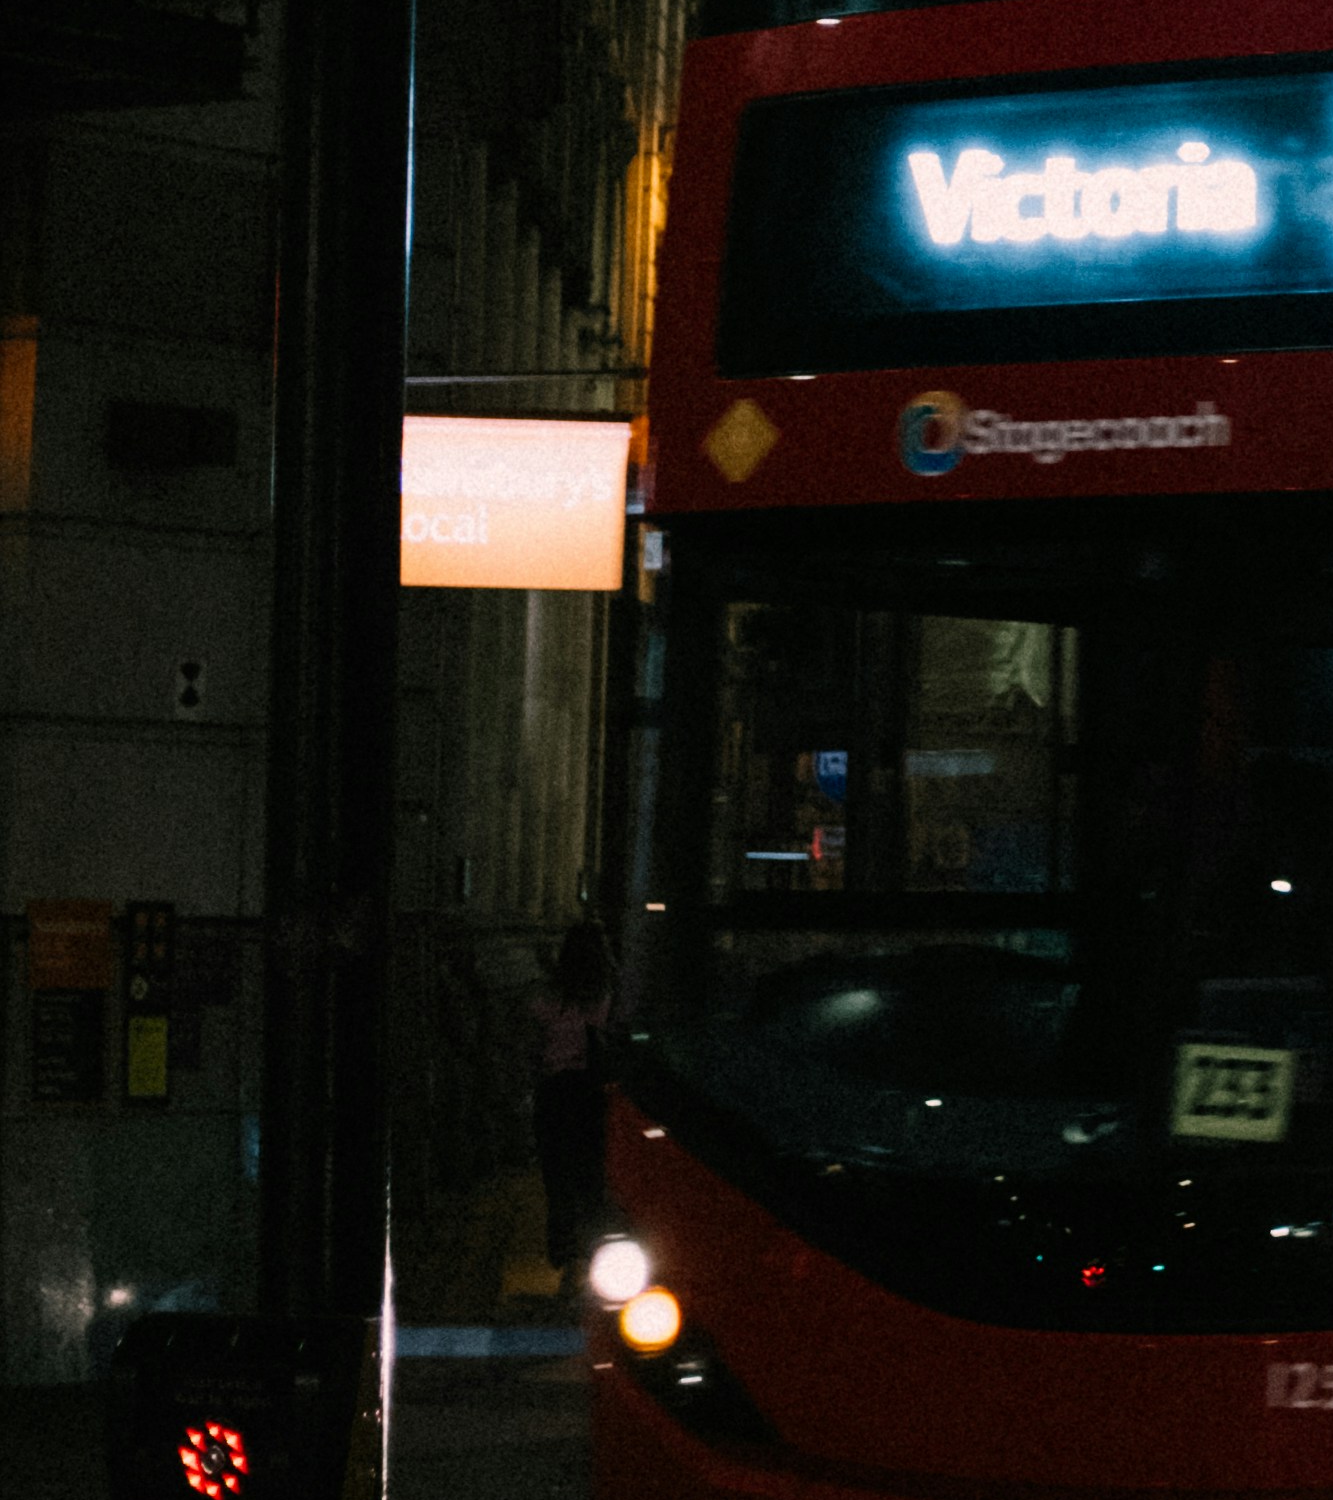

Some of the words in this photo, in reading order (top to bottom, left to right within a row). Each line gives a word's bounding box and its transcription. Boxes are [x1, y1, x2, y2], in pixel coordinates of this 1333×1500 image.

[906, 141, 1257, 246] Victoria
[960, 401, 1231, 464] Stagecoach
[403, 502, 490, 545] ocal
